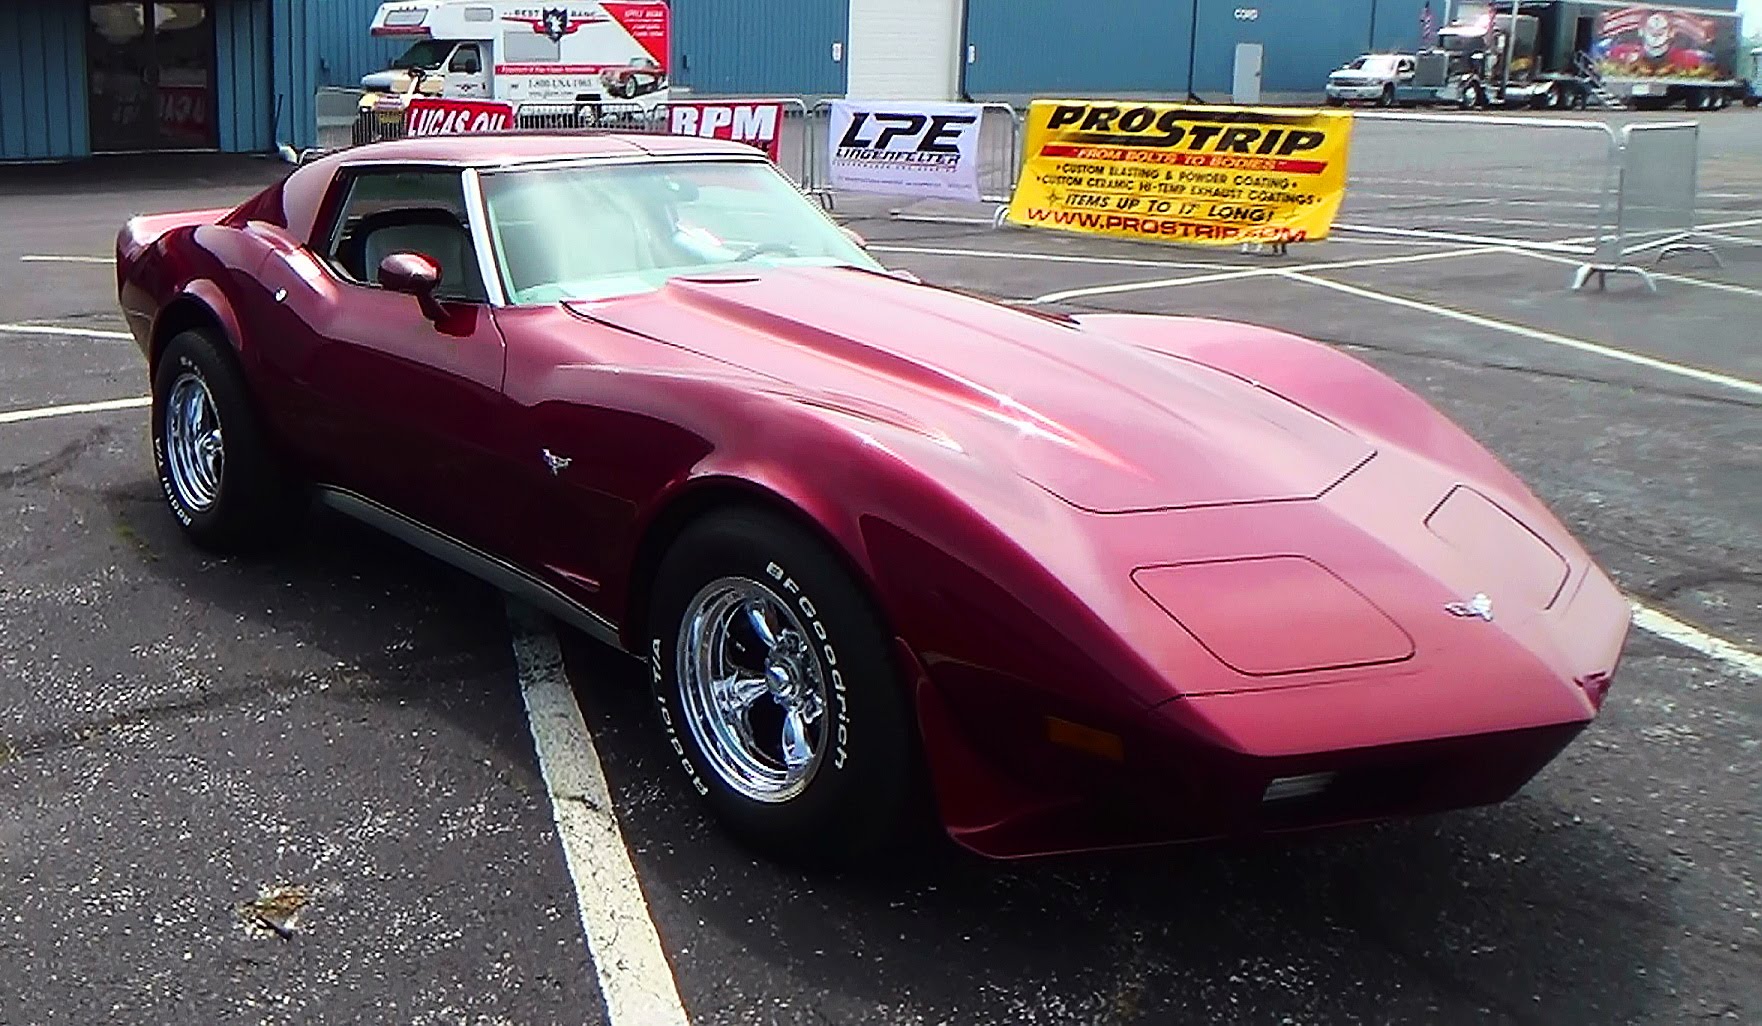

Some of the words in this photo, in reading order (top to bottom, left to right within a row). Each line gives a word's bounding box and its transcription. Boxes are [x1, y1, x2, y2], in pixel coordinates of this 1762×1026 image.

[408, 108, 471, 136] LUCAS
[672, 105, 778, 140] RPM
[839, 112, 977, 153] LPE
[1046, 104, 1326, 155] PROSTRIP
[836, 148, 961, 165] LINGENFELTER
[1126, 151, 1177, 164] BOLTS
[1184, 155, 1205, 167] TO
[1087, 178, 1134, 190] CERAMIC
[1139, 181, 1187, 194] HI-TEMP
[1190, 185, 1243, 199] EXHAUST
[1180, 171, 1228, 183] POWDER
[1065, 193, 1110, 208] ITEMS
[1117, 197, 1141, 210] UP
[1148, 199, 1171, 213] TO
[1208, 204, 1275, 222] LONG!
